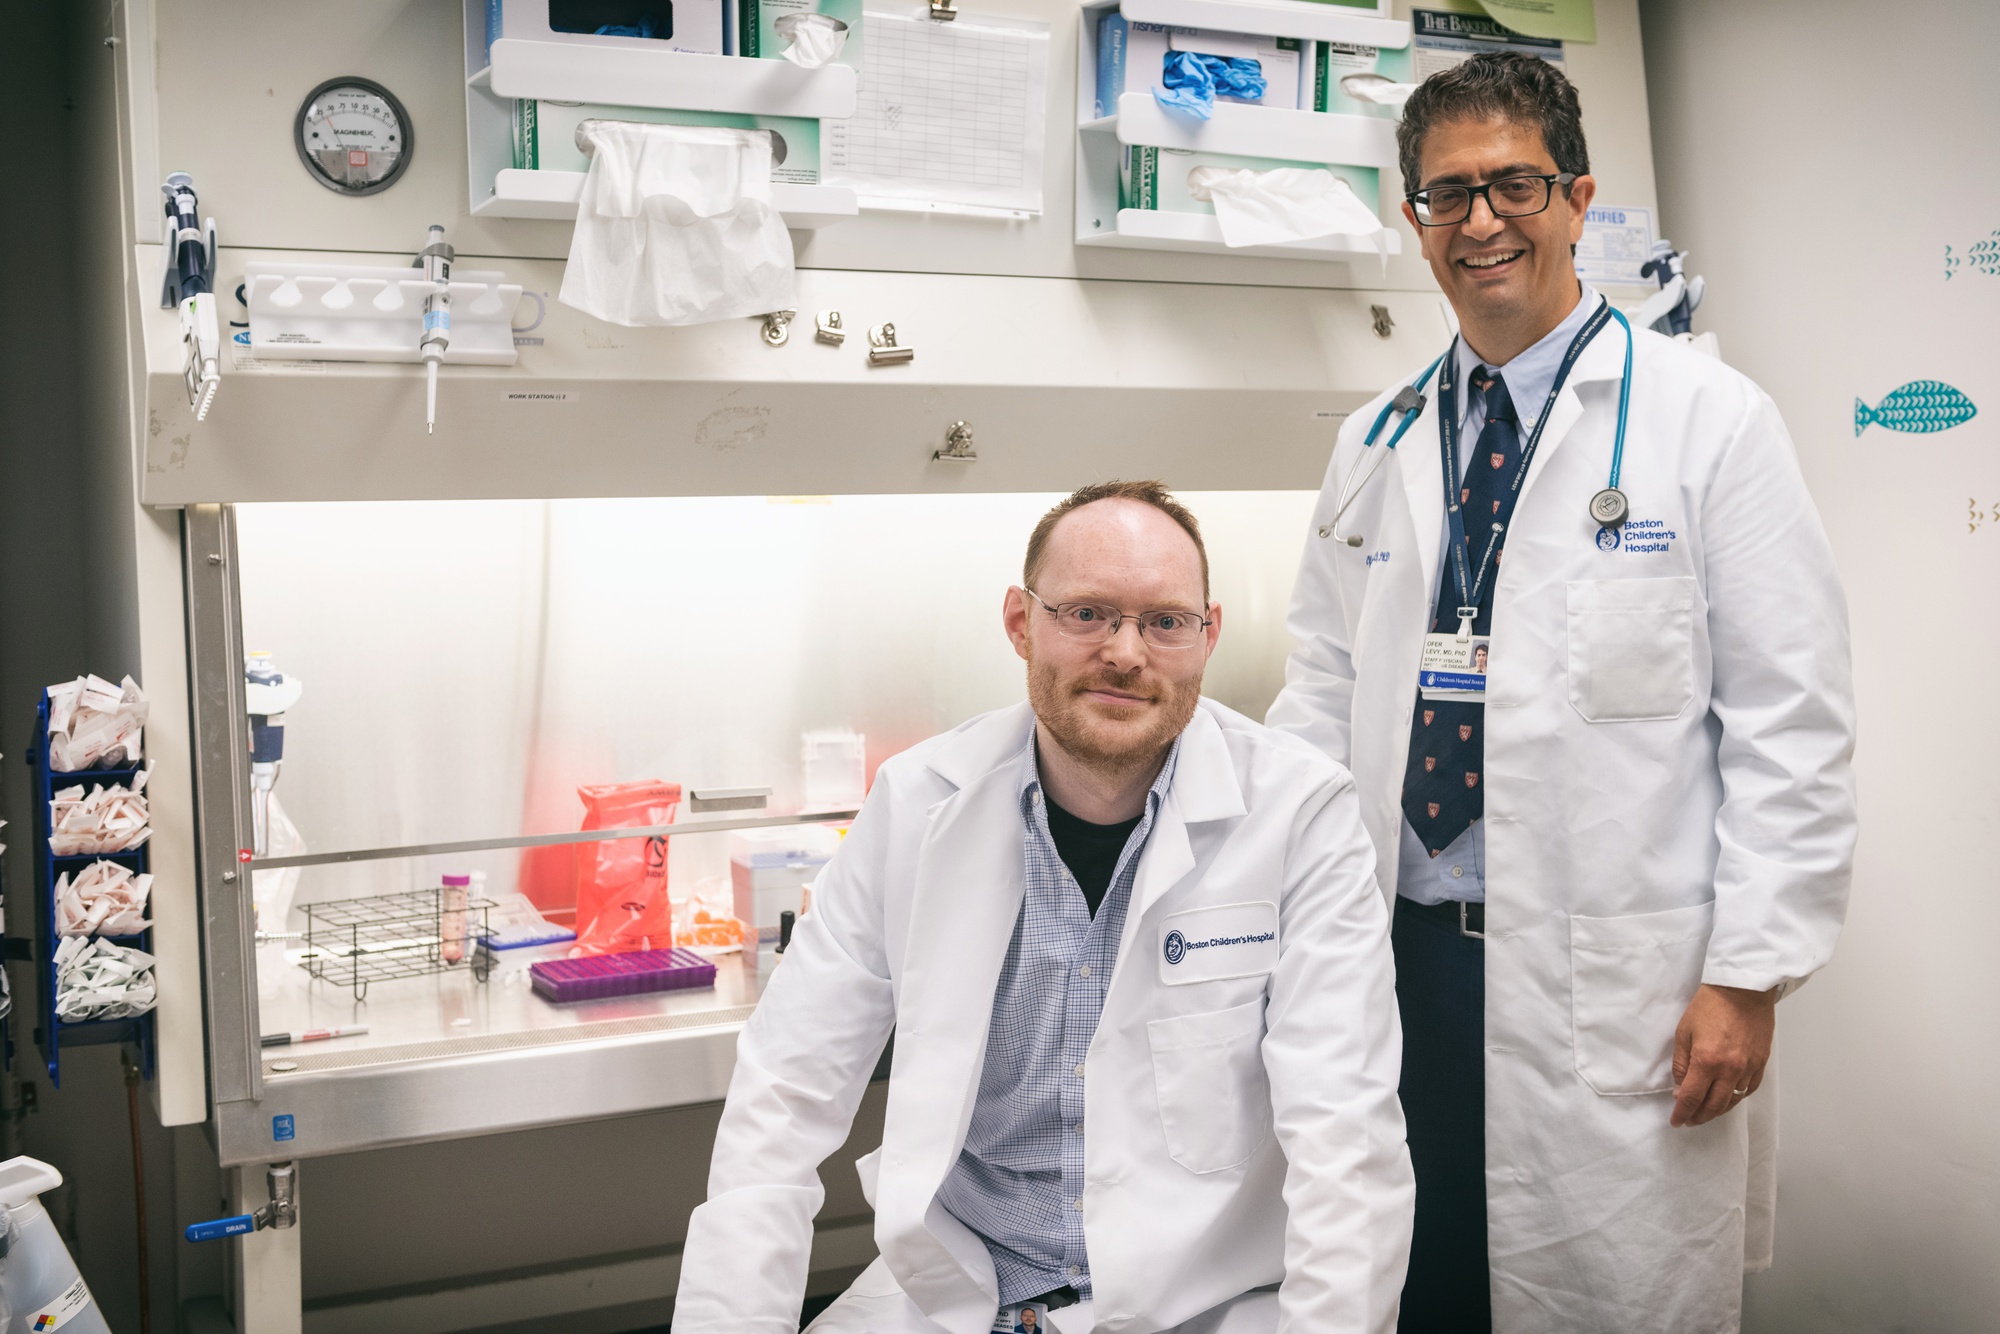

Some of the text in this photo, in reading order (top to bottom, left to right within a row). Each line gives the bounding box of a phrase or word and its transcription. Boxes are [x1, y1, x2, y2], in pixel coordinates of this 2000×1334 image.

[1421, 12, 1448, 30] THE
[1450, 15, 1491, 34] BAKER
[1143, 146, 1152, 209] KIMTEC
[1584, 211, 1626, 224] RTIFIED
[1523, 447, 1532, 464] Security
[1624, 519, 1663, 530] Boston
[1625, 530, 1676, 541] Children's
[1625, 543, 1669, 553] Hospital
[1455, 677, 1471, 685] Hospital
[1186, 931, 1275, 950] Boston Children's Hospital
[226, 1224, 246, 1233] DRAIN
